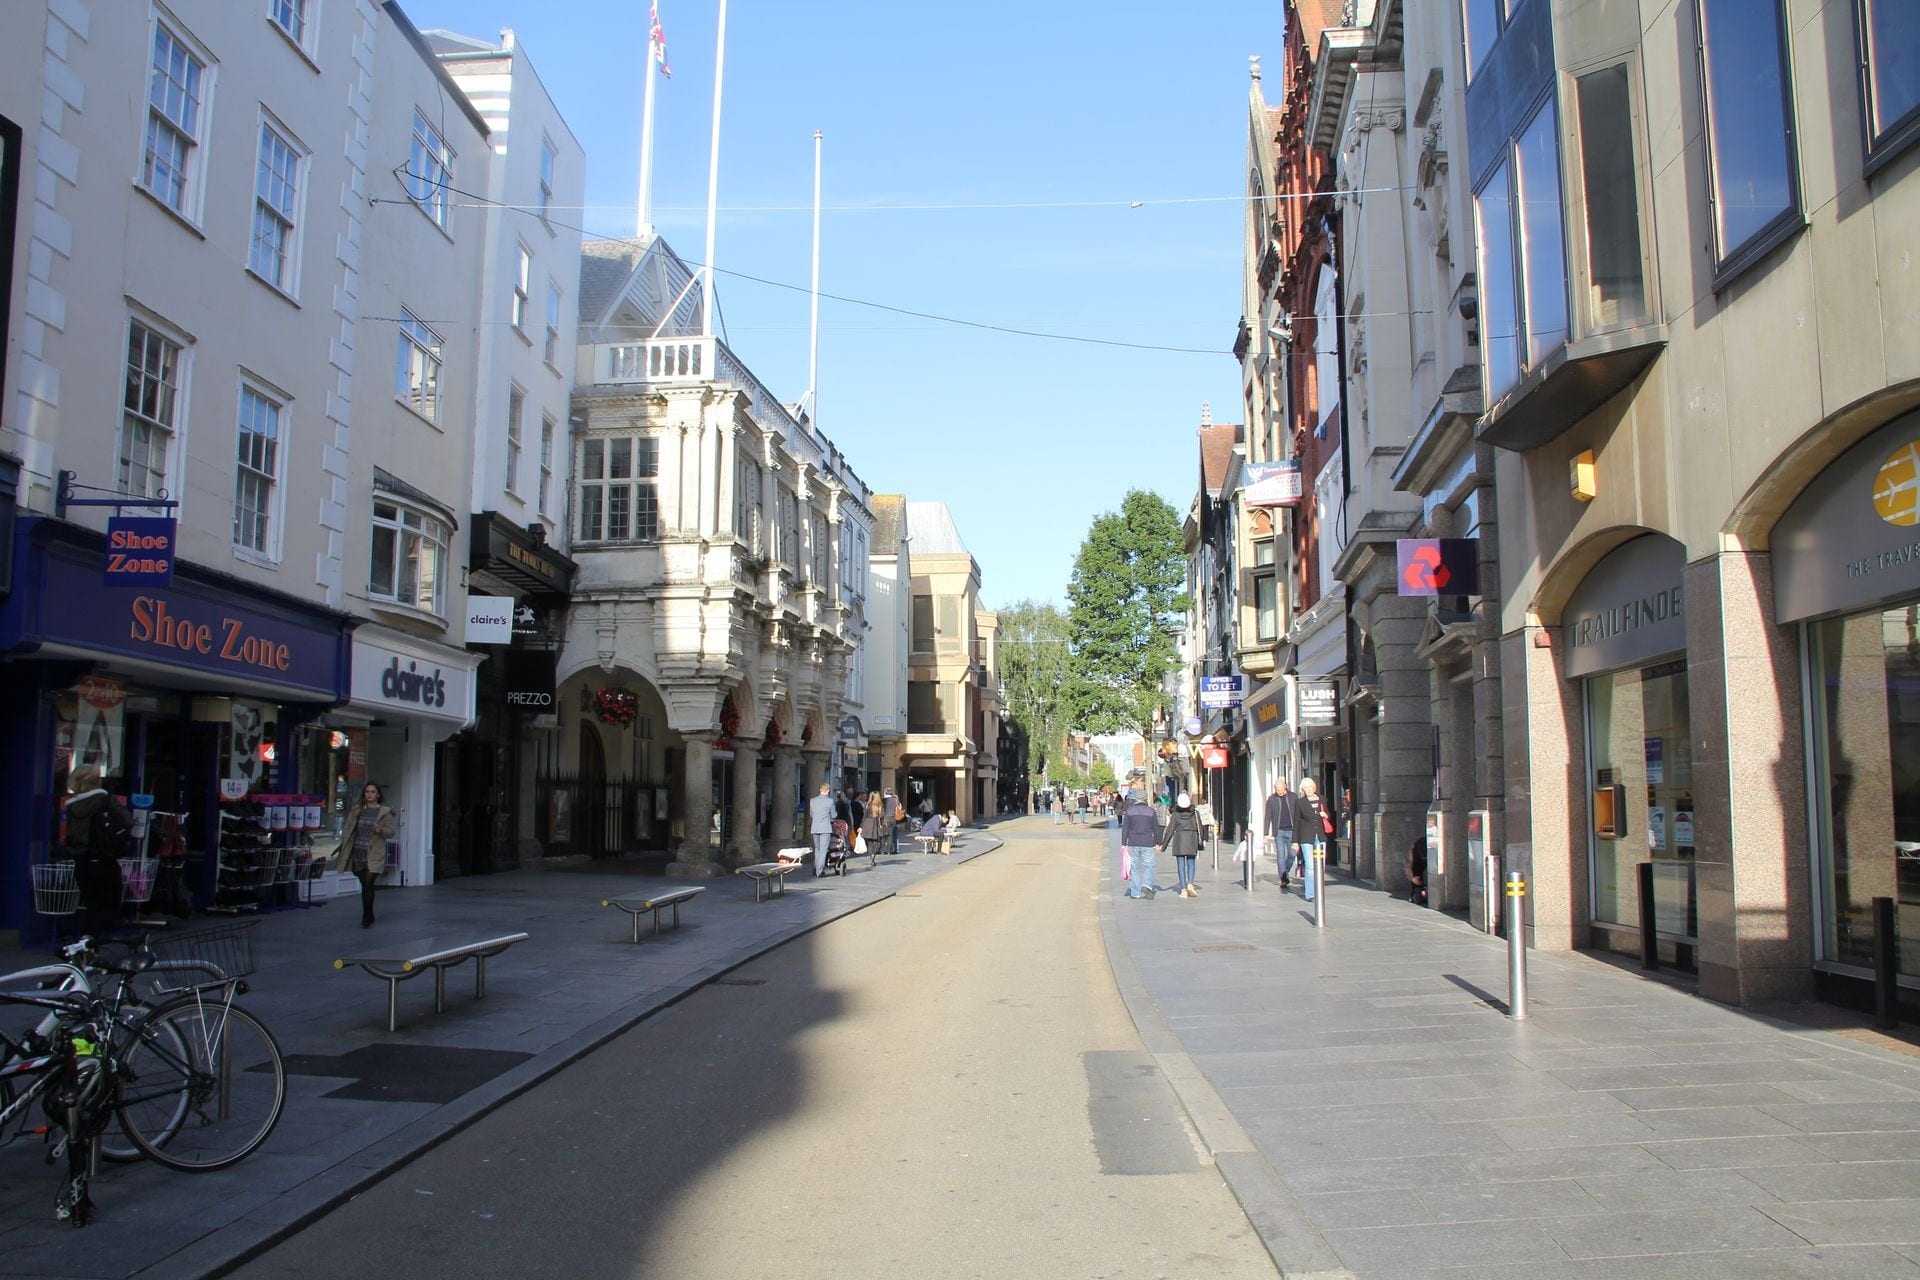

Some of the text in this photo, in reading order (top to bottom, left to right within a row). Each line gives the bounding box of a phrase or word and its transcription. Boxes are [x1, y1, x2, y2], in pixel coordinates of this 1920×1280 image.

[111, 531, 169, 549] Shoe
[107, 554, 169, 574] Zone
[1847, 558, 1871, 579] THE
[470, 615, 507, 625] claire's
[131, 595, 291, 671] Shoe Zone
[382, 656, 446, 708] claire's
[1206, 682, 1237, 691] TO LET
[507, 691, 552, 706] PREZZO
[1301, 688, 1336, 700] LUSH
